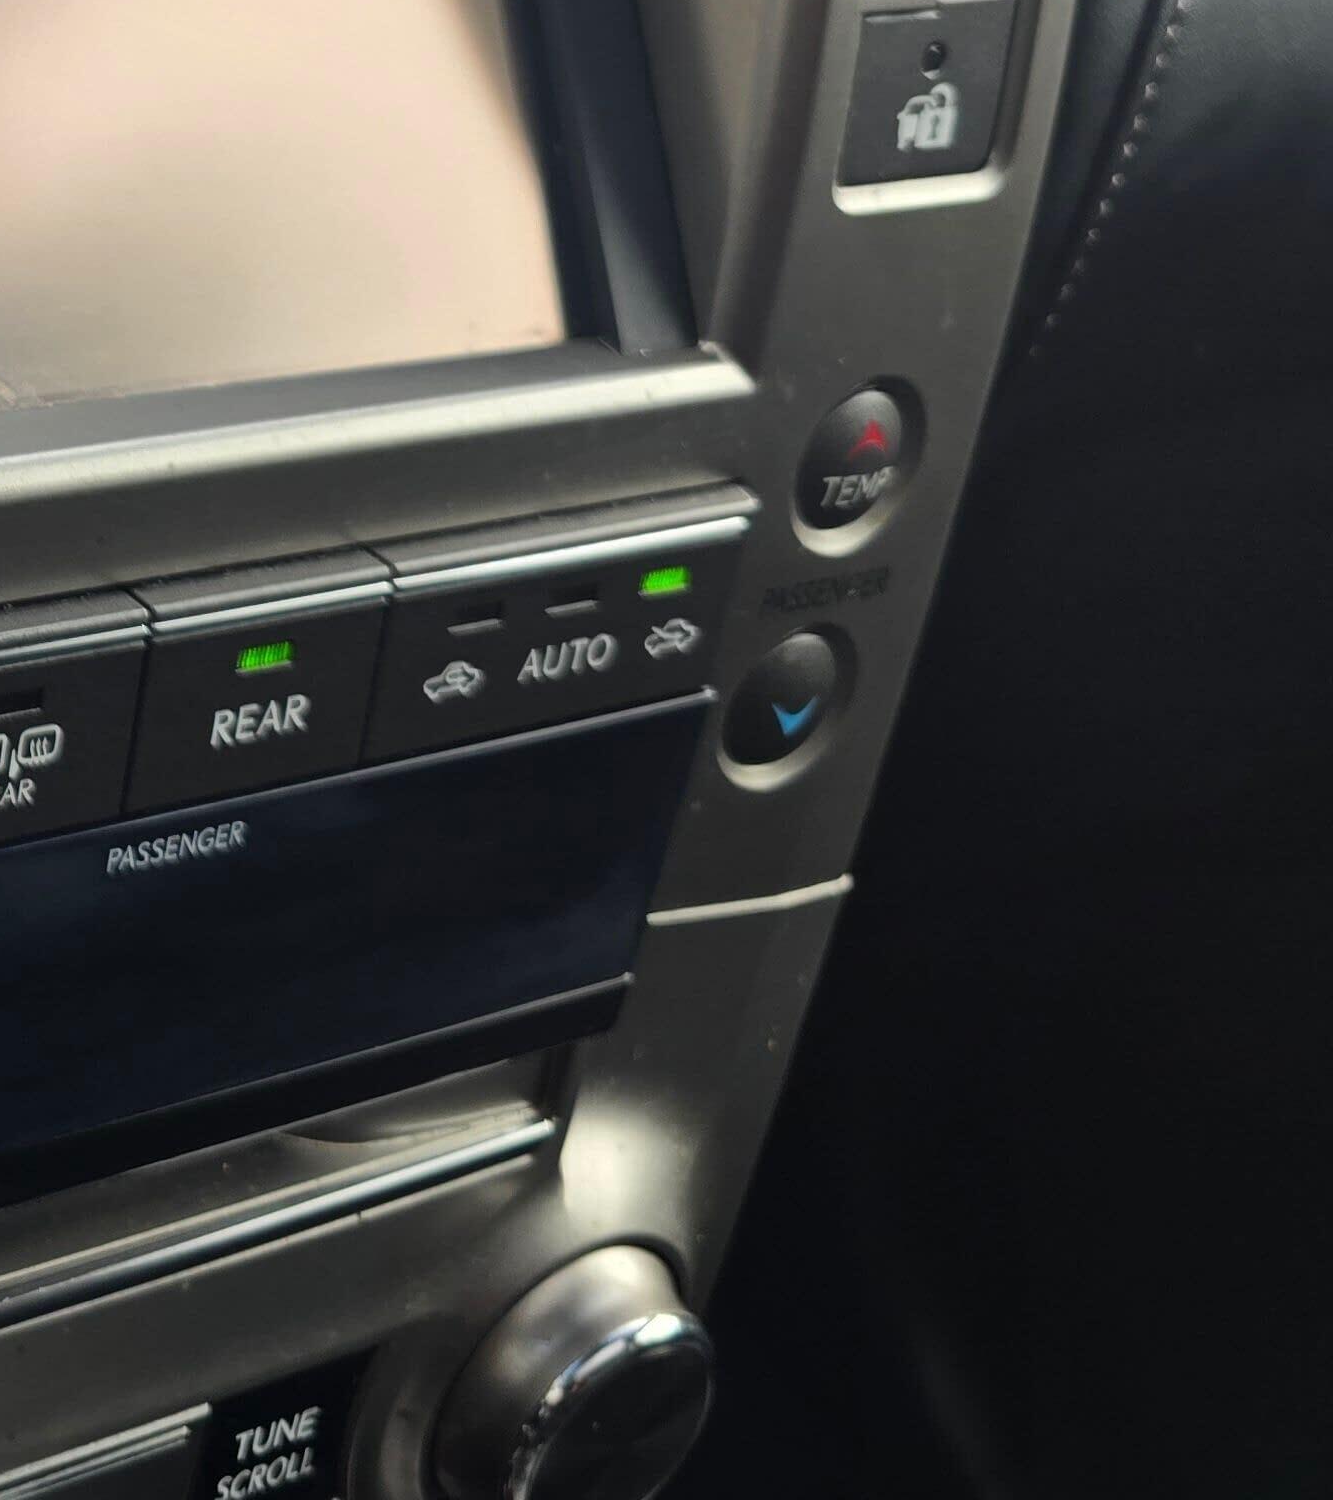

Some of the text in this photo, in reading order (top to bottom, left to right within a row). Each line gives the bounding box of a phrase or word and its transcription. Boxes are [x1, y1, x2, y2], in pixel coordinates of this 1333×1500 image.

[820, 465, 899, 508] TEMP
[517, 632, 619, 684] AUTO
[210, 693, 311, 750] REAR
[106, 819, 247, 876] PASSENGER
[235, 1405, 323, 1461] TUNE
[214, 1448, 316, 1500] SCROLL
